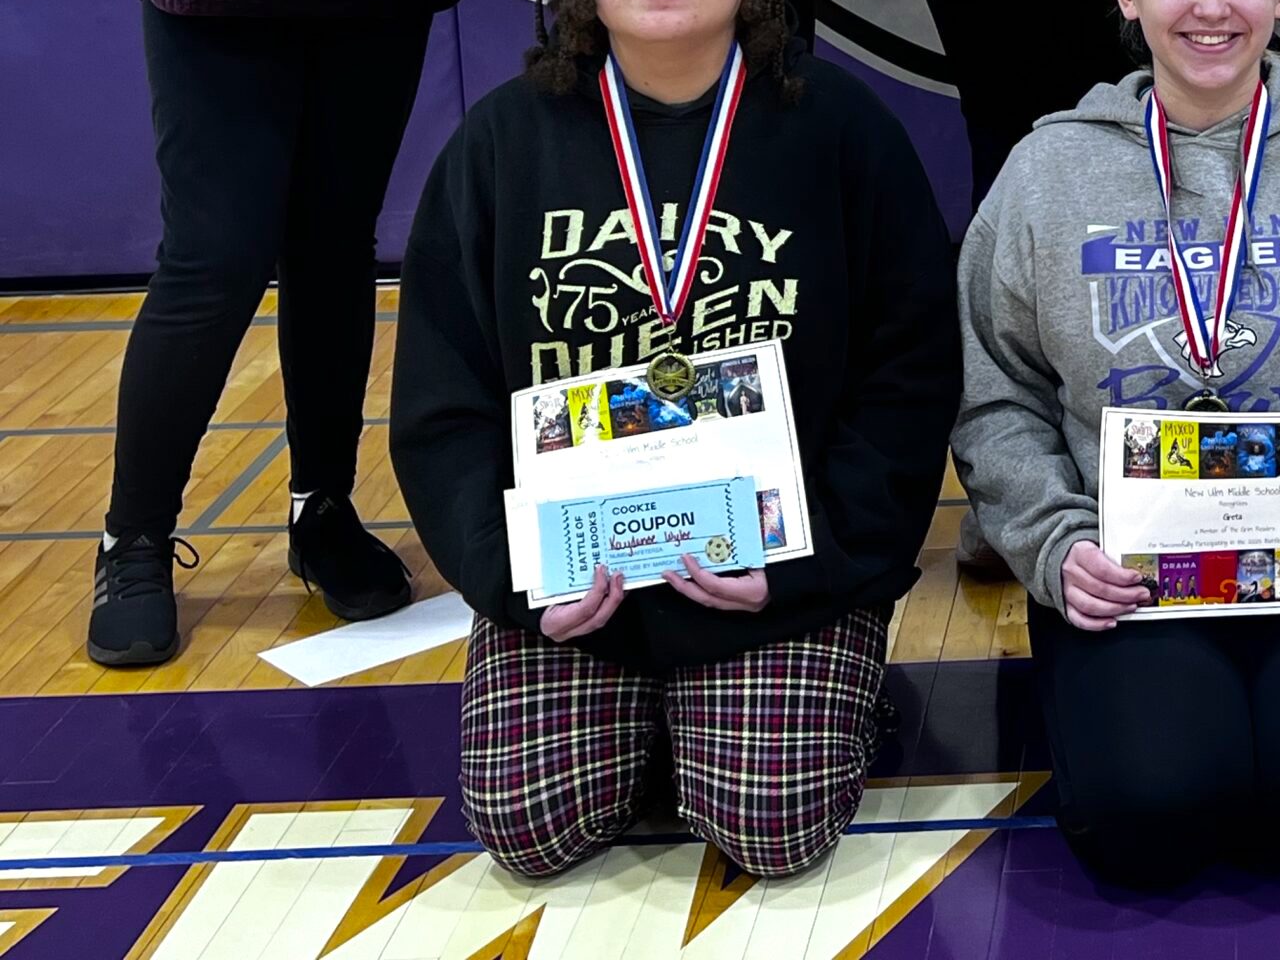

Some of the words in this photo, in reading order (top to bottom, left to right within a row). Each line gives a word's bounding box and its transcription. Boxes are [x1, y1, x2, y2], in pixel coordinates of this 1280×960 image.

[541, 202, 793, 263] DAIRY
[1125, 218, 1200, 242] NEW
[553, 283, 620, 333] 75
[1164, 422, 1195, 437] MIXED
[1182, 437, 1193, 450] UP
[1185, 488, 1204, 497] New
[1208, 488, 1224, 497] Ulm
[1228, 486, 1250, 496] Middle
[612, 501, 657, 516] COOKIE
[1222, 512, 1243, 520] Greta
[574, 515, 584, 530] OF
[588, 511, 600, 549] BOOKS
[613, 511, 696, 535] COUPON
[576, 531, 588, 572] BATTLE
[1162, 561, 1197, 570] DRAMA
